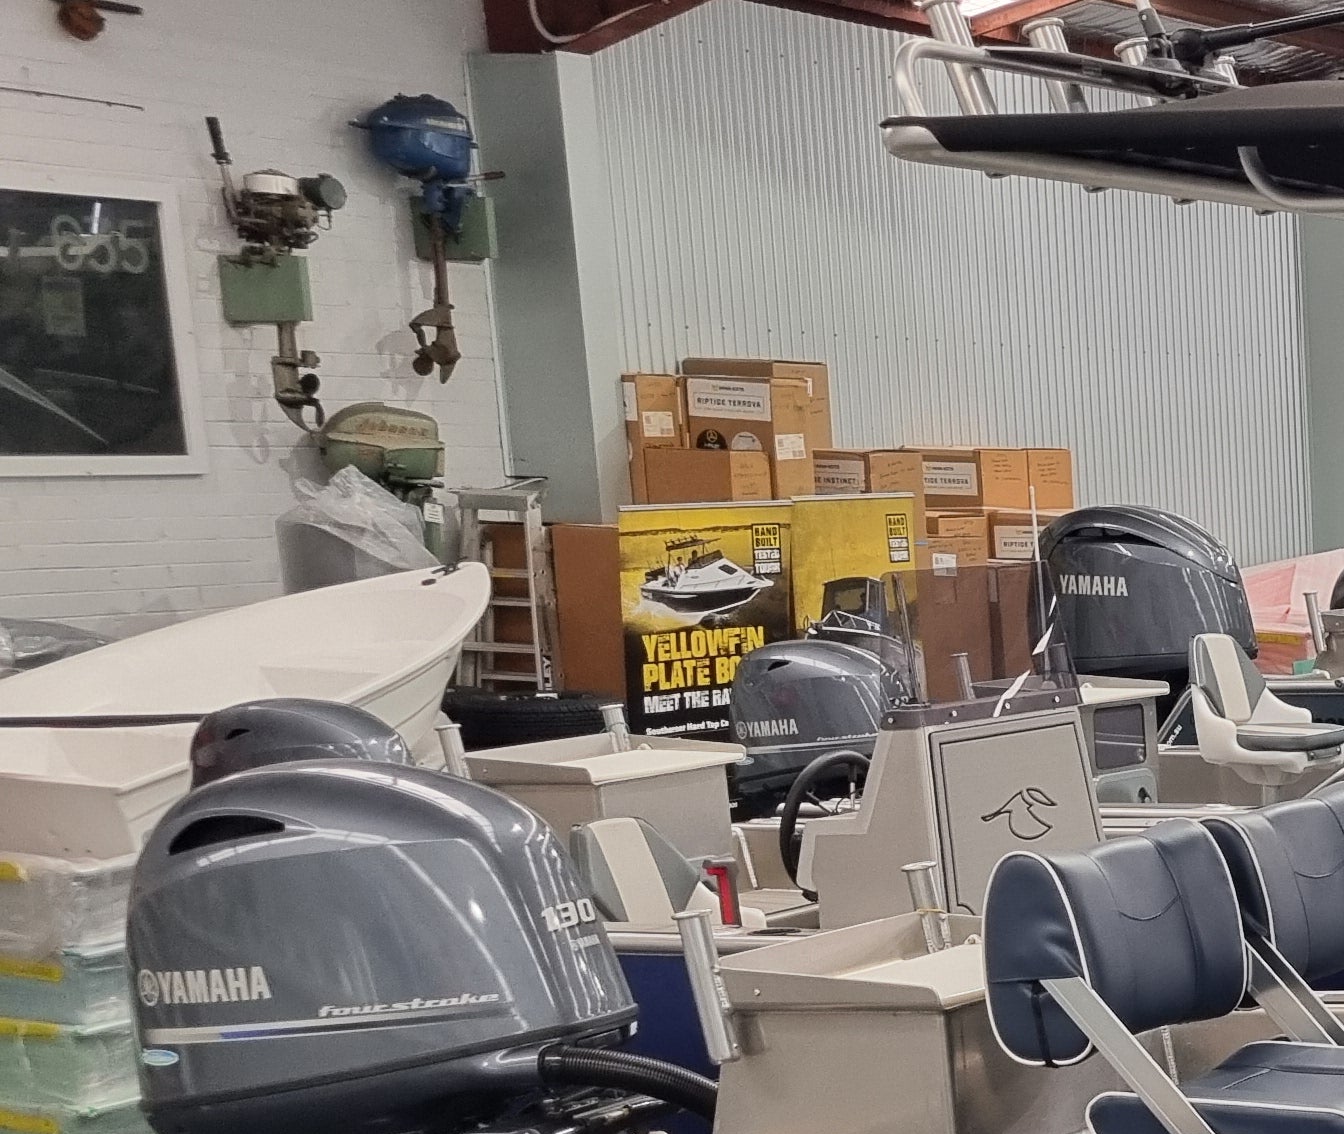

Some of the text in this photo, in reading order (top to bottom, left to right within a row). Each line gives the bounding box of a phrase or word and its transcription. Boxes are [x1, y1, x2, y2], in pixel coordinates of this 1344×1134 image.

[924, 477, 938, 485] TIDE
[1060, 574, 1129, 597] YAMAHA
[642, 625, 765, 663] YELLOWFIN
[643, 655, 742, 692] PLATE BO
[643, 688, 732, 714] MEET THE RA
[747, 719, 799, 738] YAMAHA
[541, 897, 597, 932] 130
[156, 966, 272, 1005] YAMAHA
